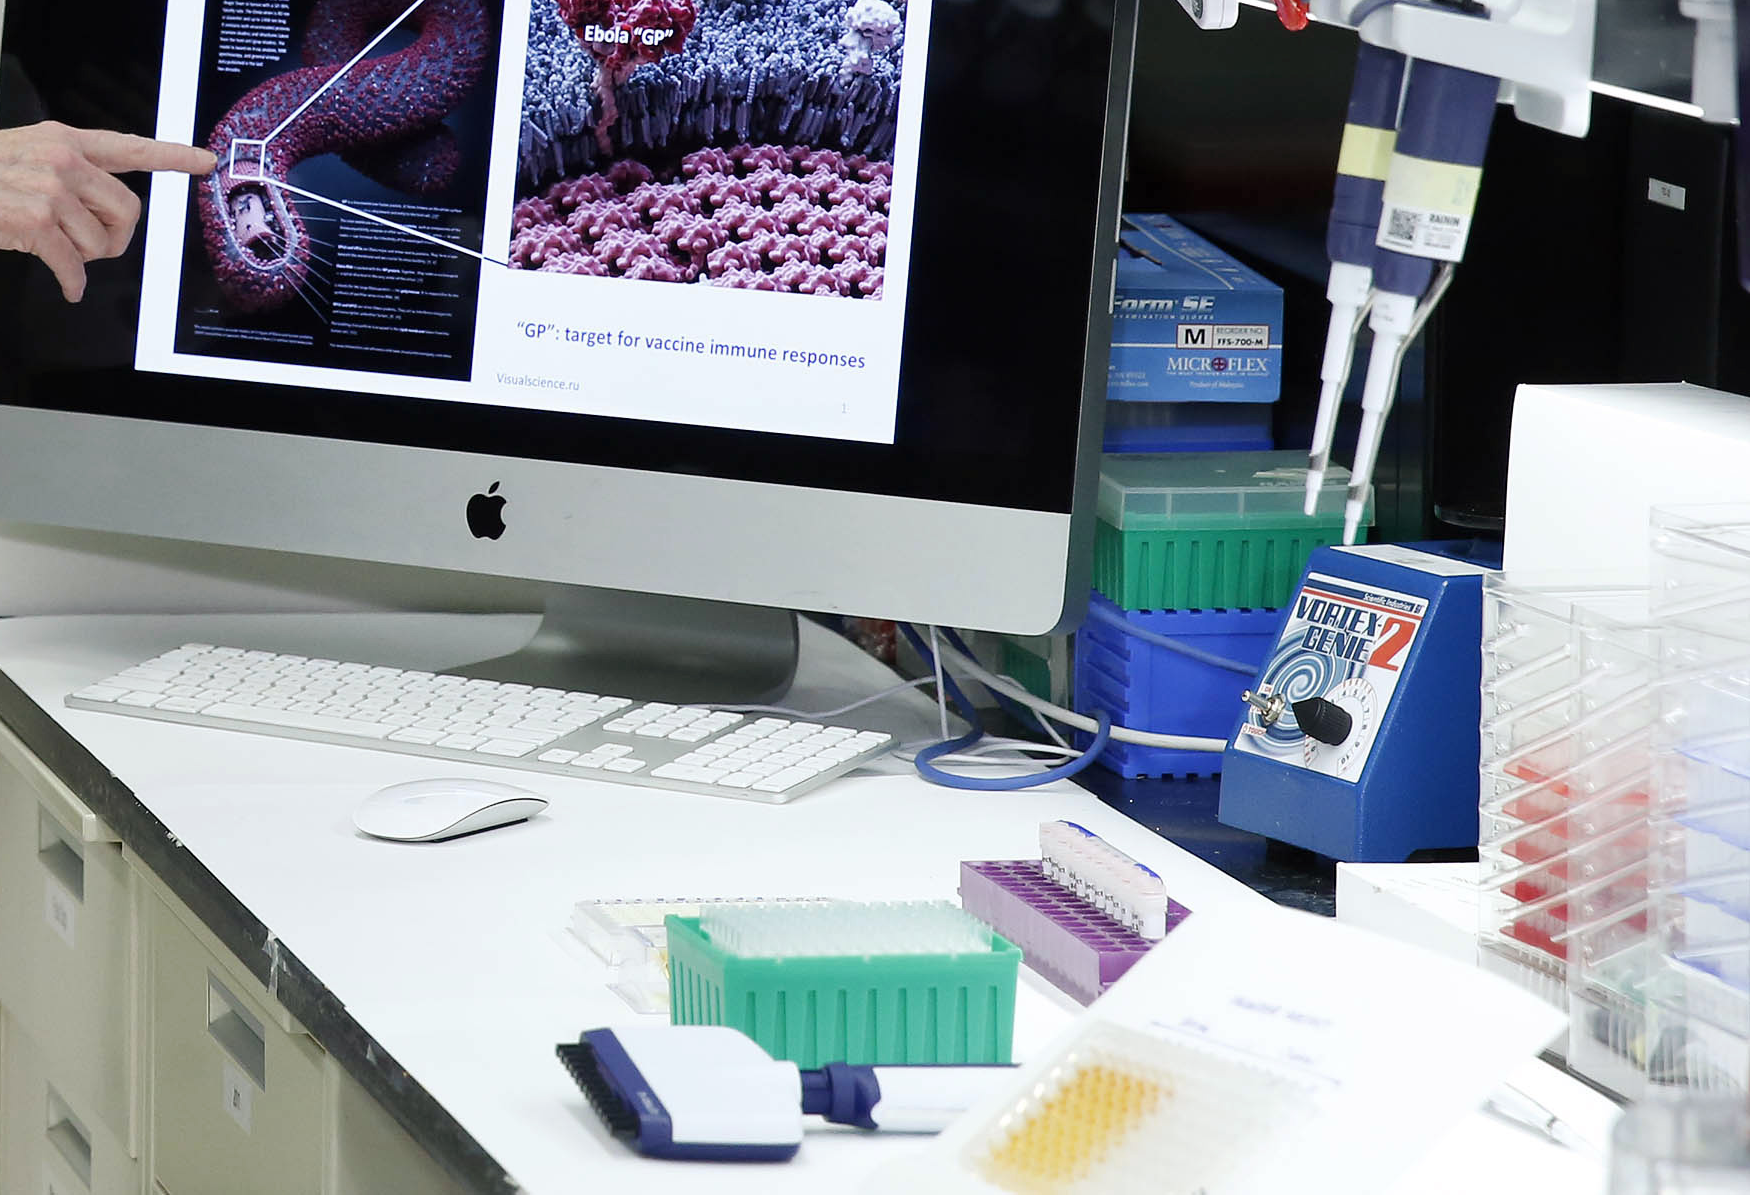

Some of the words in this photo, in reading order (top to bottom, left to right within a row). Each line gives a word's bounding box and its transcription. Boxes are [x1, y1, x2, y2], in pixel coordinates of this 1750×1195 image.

[585, 25, 629, 44] Ebola
[1182, 296, 1215, 311] SE
[1185, 329, 1205, 344] M
[564, 326, 611, 348] target
[617, 329, 640, 346] for
[645, 336, 704, 352] vaccine
[709, 339, 777, 360] immune
[782, 348, 865, 369] responses
[496, 374, 579, 390] Visualscience.ru
[1364, 593, 1386, 605] Scientific
[1386, 599, 1412, 611] Industries
[1301, 625, 1373, 662] GENIE
[1369, 617, 1416, 672] 2
